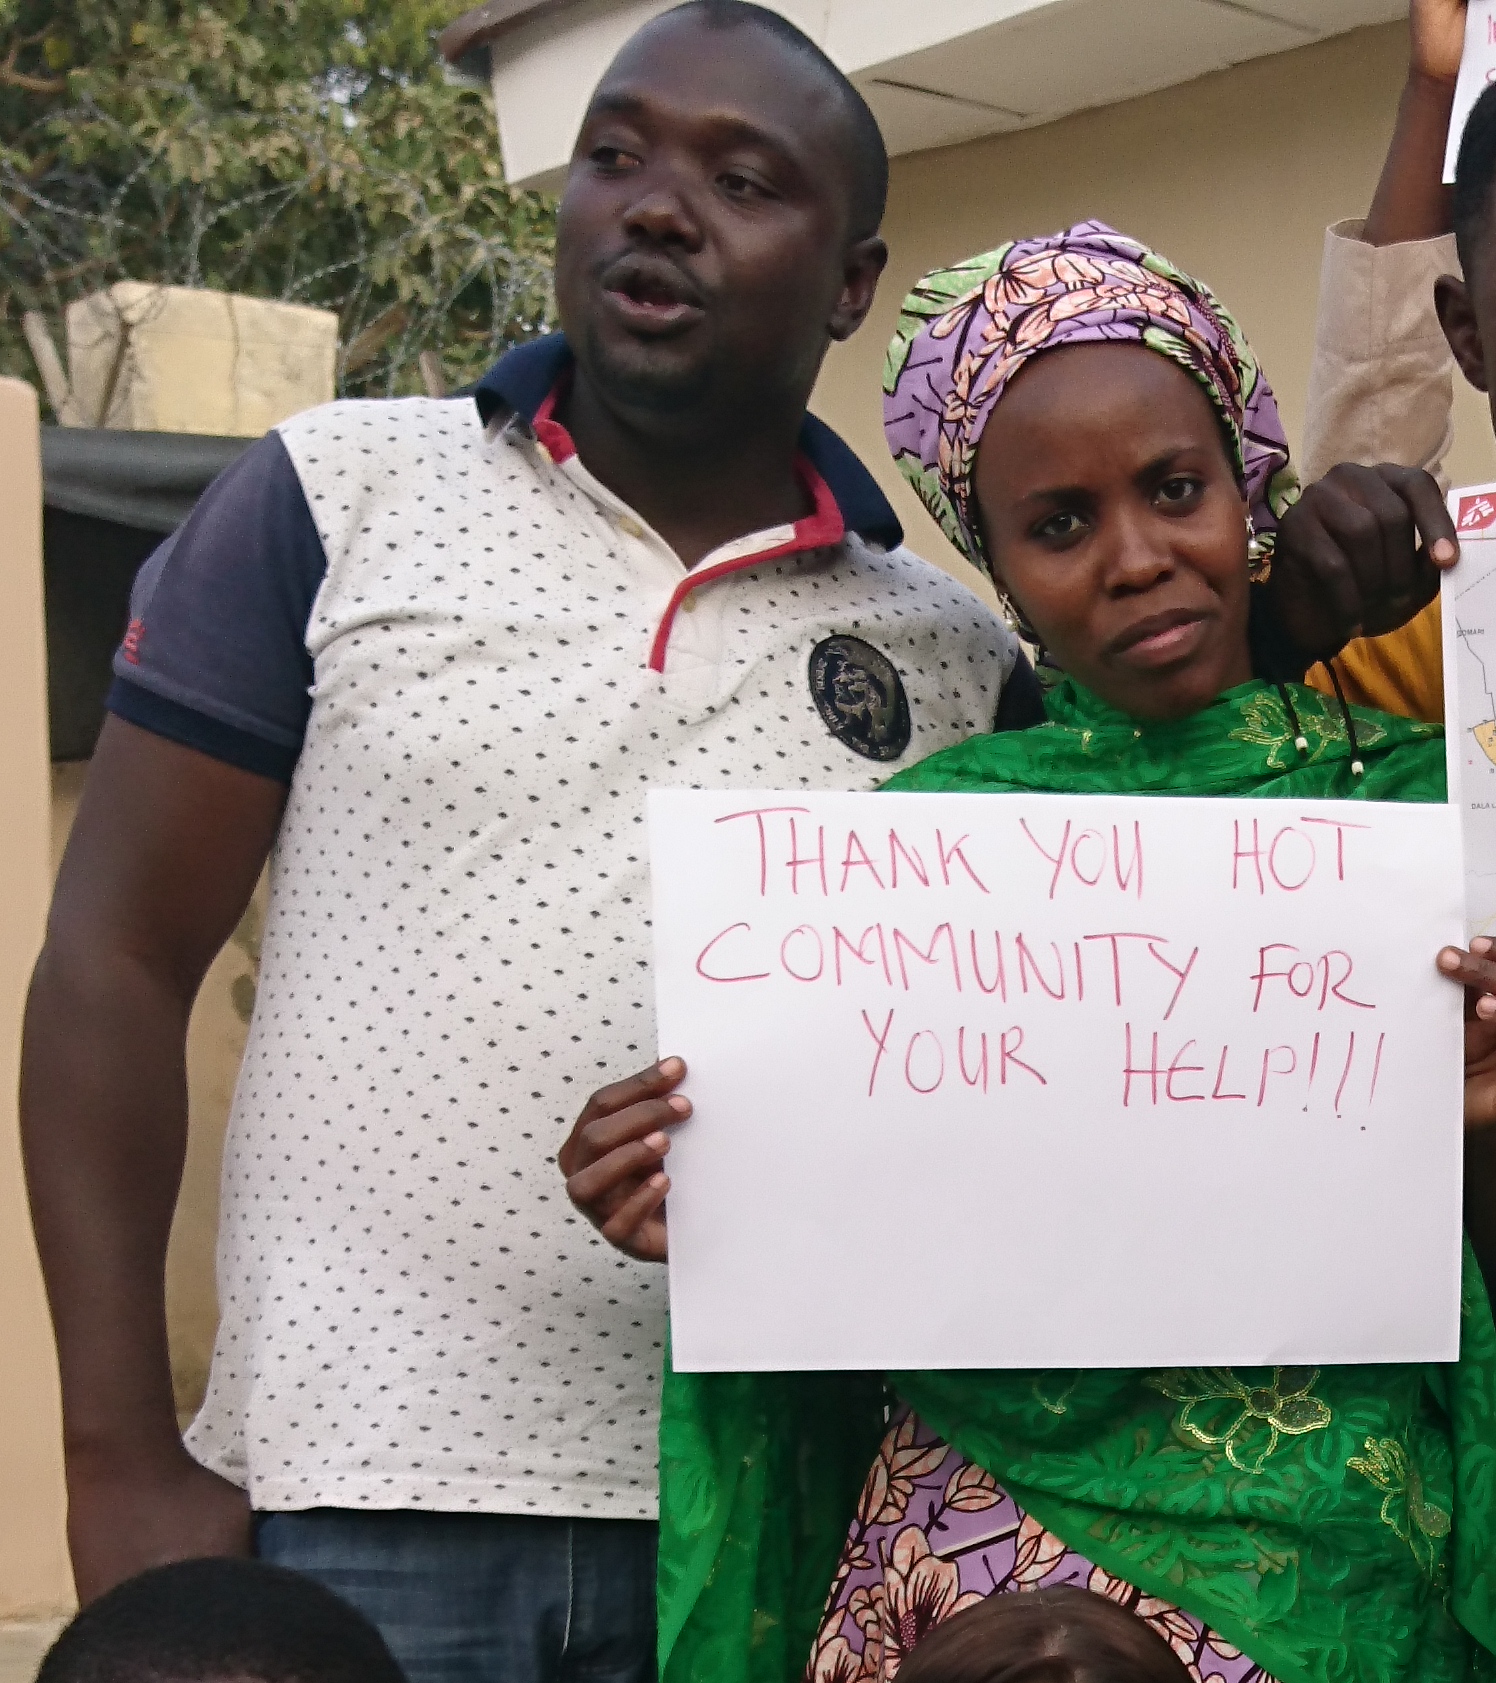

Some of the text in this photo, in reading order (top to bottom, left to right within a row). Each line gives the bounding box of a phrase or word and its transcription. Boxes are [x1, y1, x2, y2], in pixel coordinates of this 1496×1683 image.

[714, 807, 1372, 900] THANK YOU HOT
[696, 922, 1377, 1020] COMMUNITY FOR
[861, 1008, 1386, 1132] YOUR HELP!!!
